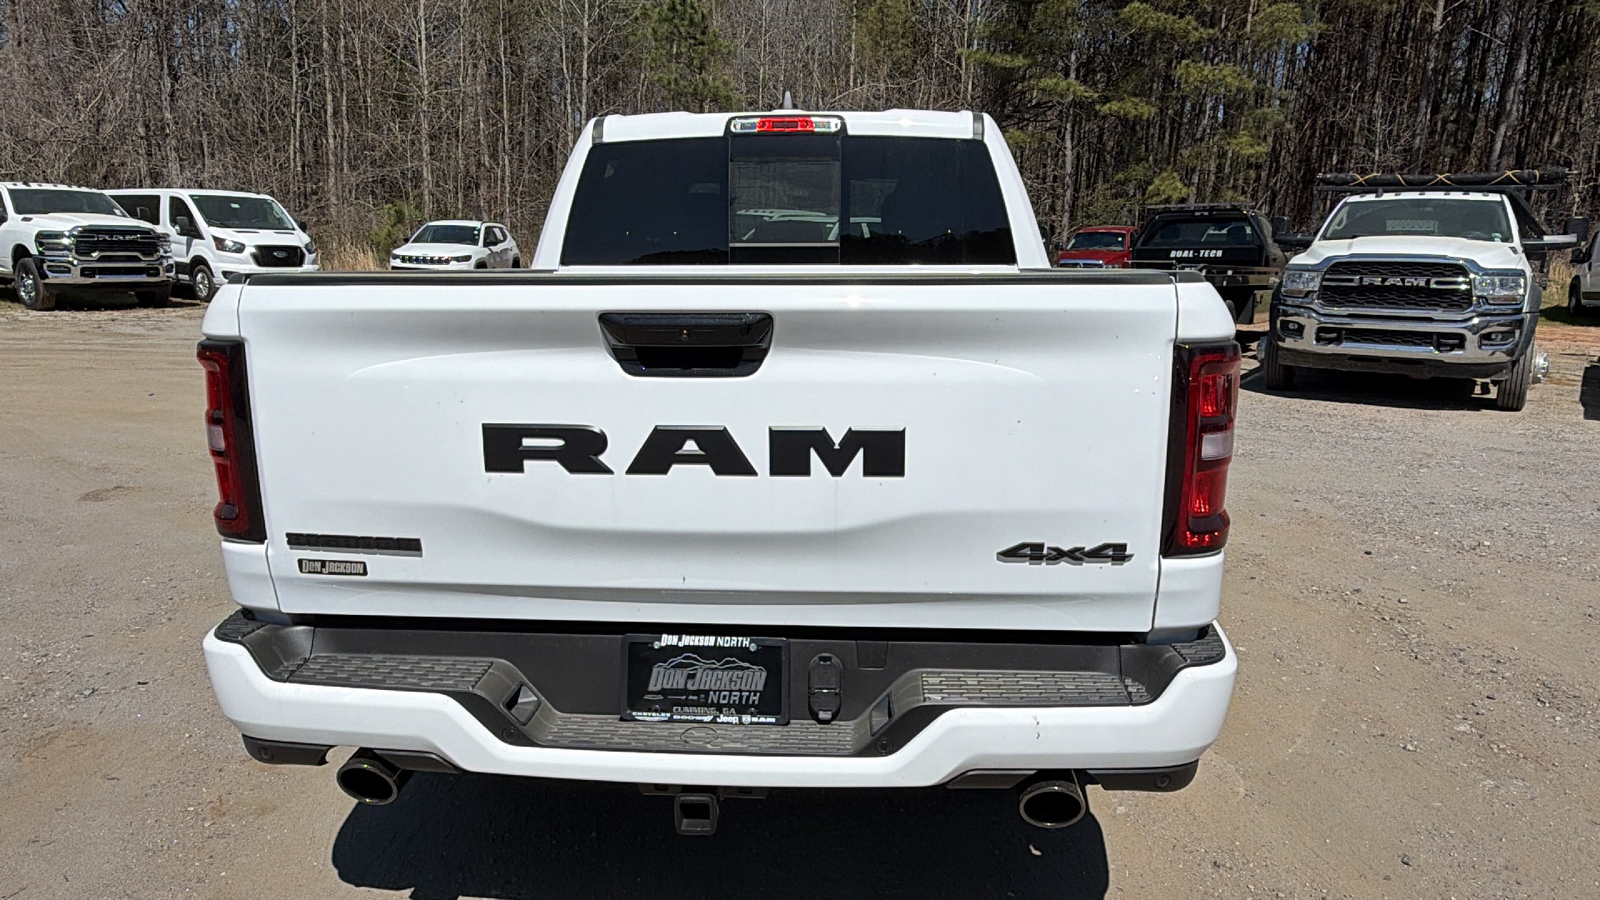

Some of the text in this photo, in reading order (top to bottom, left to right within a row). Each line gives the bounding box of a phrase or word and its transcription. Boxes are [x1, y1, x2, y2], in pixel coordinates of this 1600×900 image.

[1362, 277, 1427, 287] RAM
[481, 423, 906, 478] RAM
[322, 561, 364, 574] JACKSON
[716, 636, 750, 648] NORTH
[647, 668, 767, 691] DON JACKSON
[708, 692, 760, 705] NORTH
[673, 706, 719, 715] CUMMING,
[717, 714, 739, 724] Jeep
